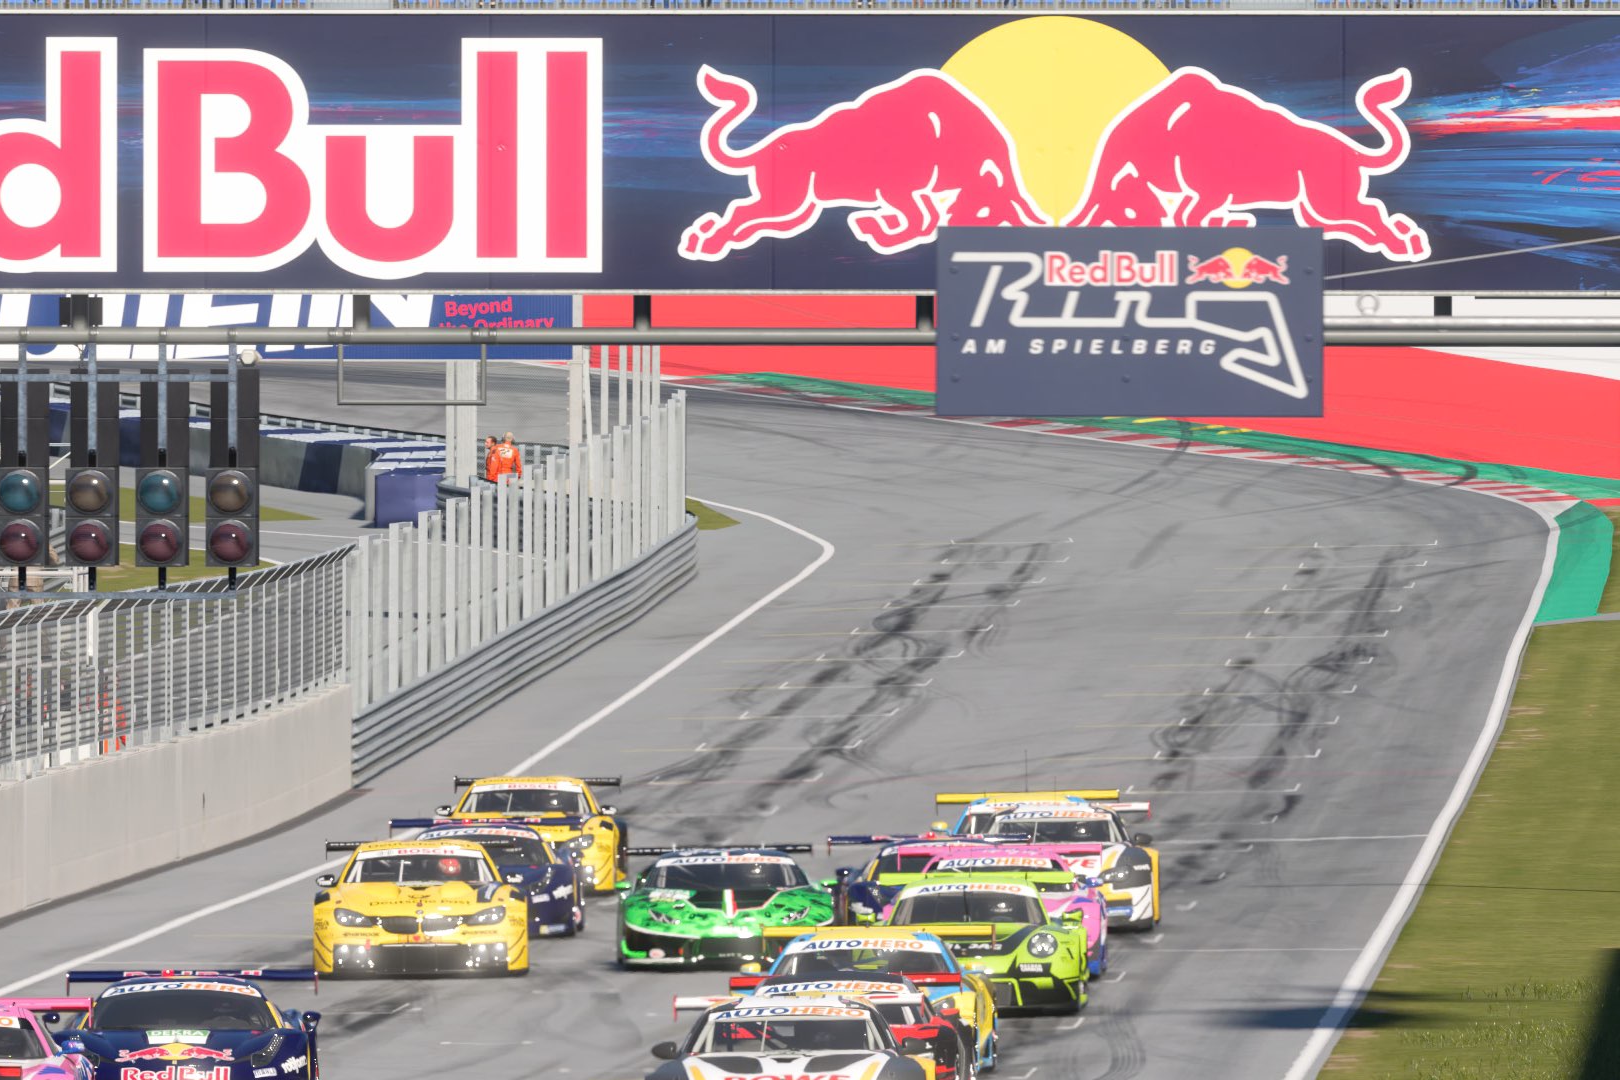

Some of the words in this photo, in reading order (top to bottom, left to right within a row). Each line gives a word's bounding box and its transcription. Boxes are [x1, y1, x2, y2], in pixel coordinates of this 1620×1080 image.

[146, 40, 599, 276] Bull
[1045, 251, 1111, 286] Red
[1113, 251, 1178, 286] Bull
[444, 296, 513, 319] Beyond
[961, 338, 1007, 355] AM
[1028, 338, 1217, 355] SPIELBERG
[1002, 811, 1107, 821] AUTOHERO
[672, 856, 781, 865] AUTOHERO
[943, 857, 1047, 868] AUTOHERO
[918, 884, 1021, 894] AUTOHERO
[803, 939, 923, 951] AUTOHERO
[114, 983, 256, 995] AUTOHERO
[765, 982, 904, 995] AUTOHERO
[716, 1006, 865, 1020] AUTOHERO
[150, 1029, 206, 1037] DEKRA
